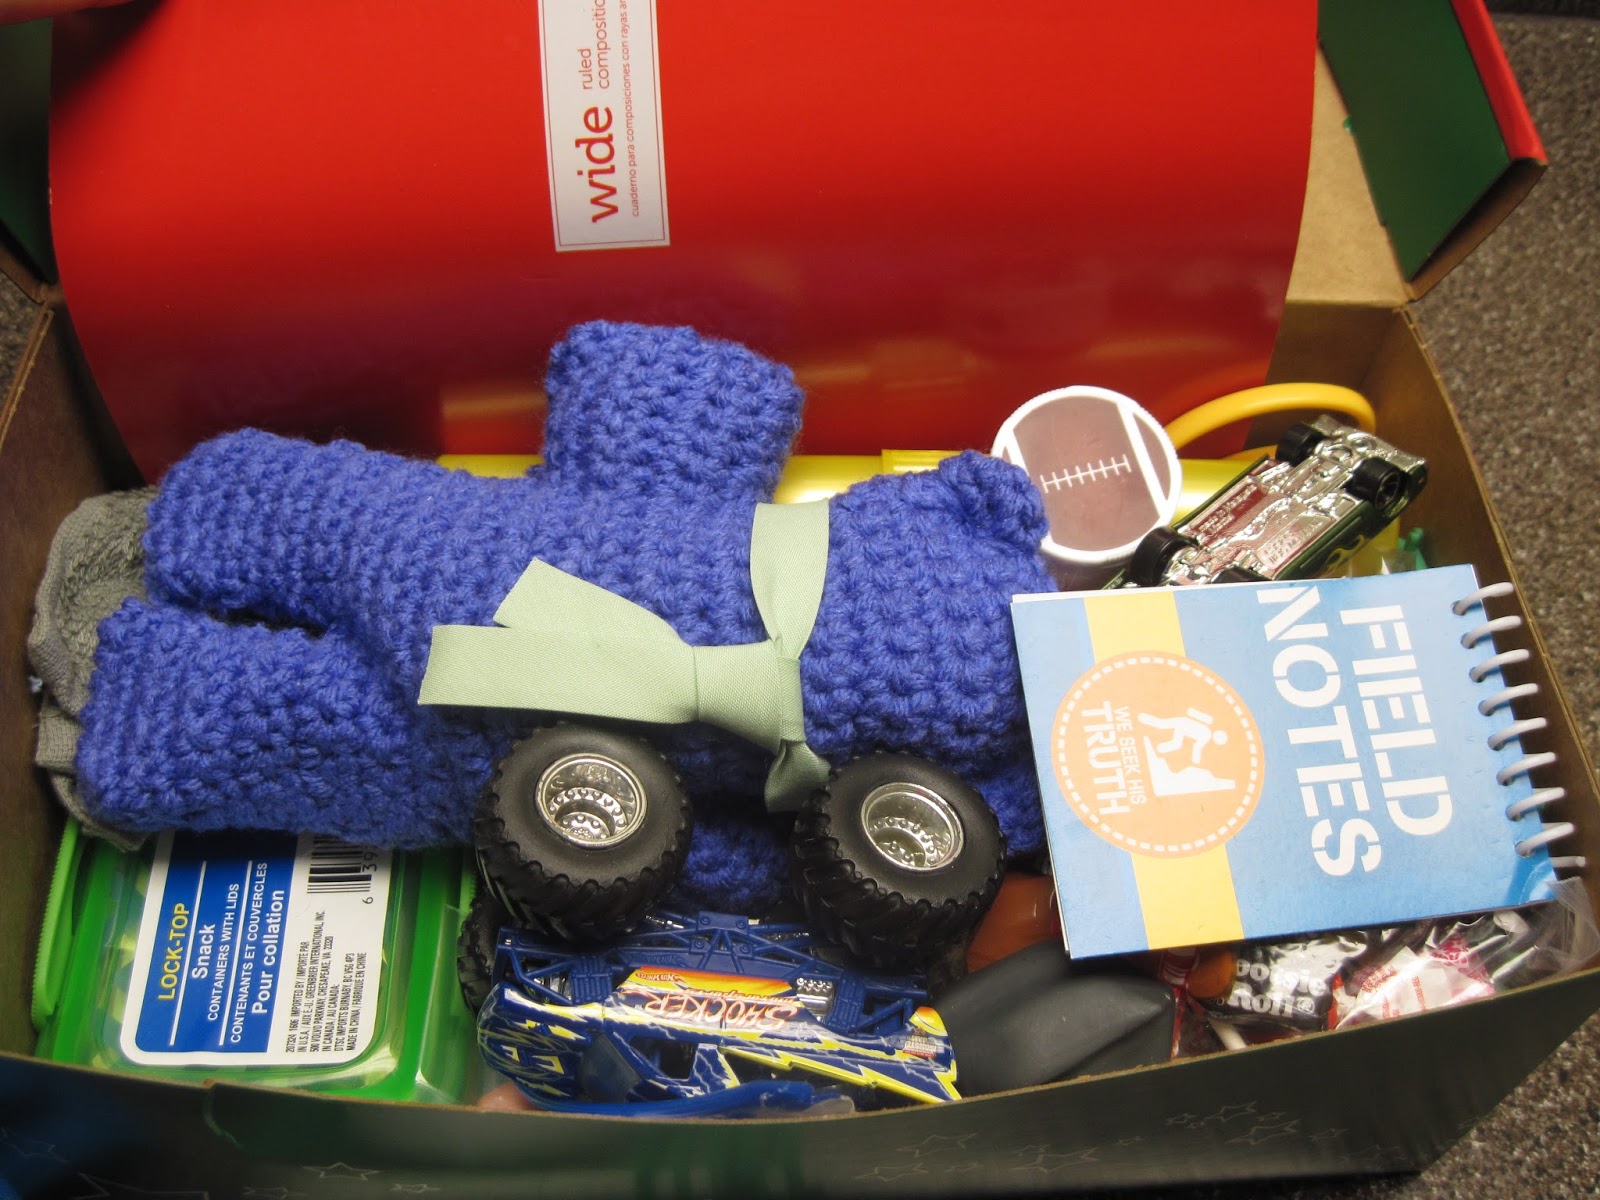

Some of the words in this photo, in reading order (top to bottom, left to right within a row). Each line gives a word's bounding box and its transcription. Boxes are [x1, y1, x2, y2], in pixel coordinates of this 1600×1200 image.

[620, 9, 629, 39] rayas
[621, 42, 630, 62] con
[578, 48, 593, 90] ruled
[622, 63, 635, 142] composiciones
[575, 106, 618, 223] wide
[626, 144, 636, 167] para
[627, 169, 639, 217] cuaderno
[1114, 706, 1133, 731] WE
[1257, 586, 1382, 877] NOTES
[1340, 604, 1453, 836] FIELD
[1081, 700, 1131, 815] TRUTH
[1120, 737, 1141, 775] SEEK
[1127, 779, 1147, 805] HIS
[226, 884, 240, 910] LIDS
[246, 862, 268, 942] COUVERCLES
[362, 897, 374, 905] 6
[221, 913, 236, 942] WITH
[260, 891, 287, 966] collation
[158, 903, 191, 1001] LOCK-TOP
[191, 924, 216, 979] Snack
[244, 946, 256, 959] ET
[300, 942, 309, 952] PAR
[310, 922, 324, 965] INTERNATIONAL,
[323, 952, 331, 960] VA
[356, 953, 367, 969] CHINE
[208, 945, 231, 1021] CONTAINERS
[252, 971, 275, 1015] Pour
[306, 966, 318, 999] GREENBRIER
[318, 961, 331, 996] CHESAPEAKE,
[352, 979, 364, 1005] FABRIQUE
[231, 963, 254, 1043] CONTENANTS
[291, 990, 303, 1016] IMPORTED
[314, 997, 327, 1024] PARKWAY,
[337, 1012, 348, 1036] IMPORTS
[343, 975, 353, 983] BC
[350, 1009, 360, 1026] CHINA
[628, 990, 798, 1031] SHOCKER
[290, 1020, 299, 1031] 1606
[302, 1014, 312, 1025] AUX
[312, 1026, 322, 1042] VOLVO
[324, 1021, 335, 1044] CANADA
[286, 1034, 297, 1053] 207324
[310, 1044, 320, 1052] 500
[347, 1034, 357, 1051] MADE
